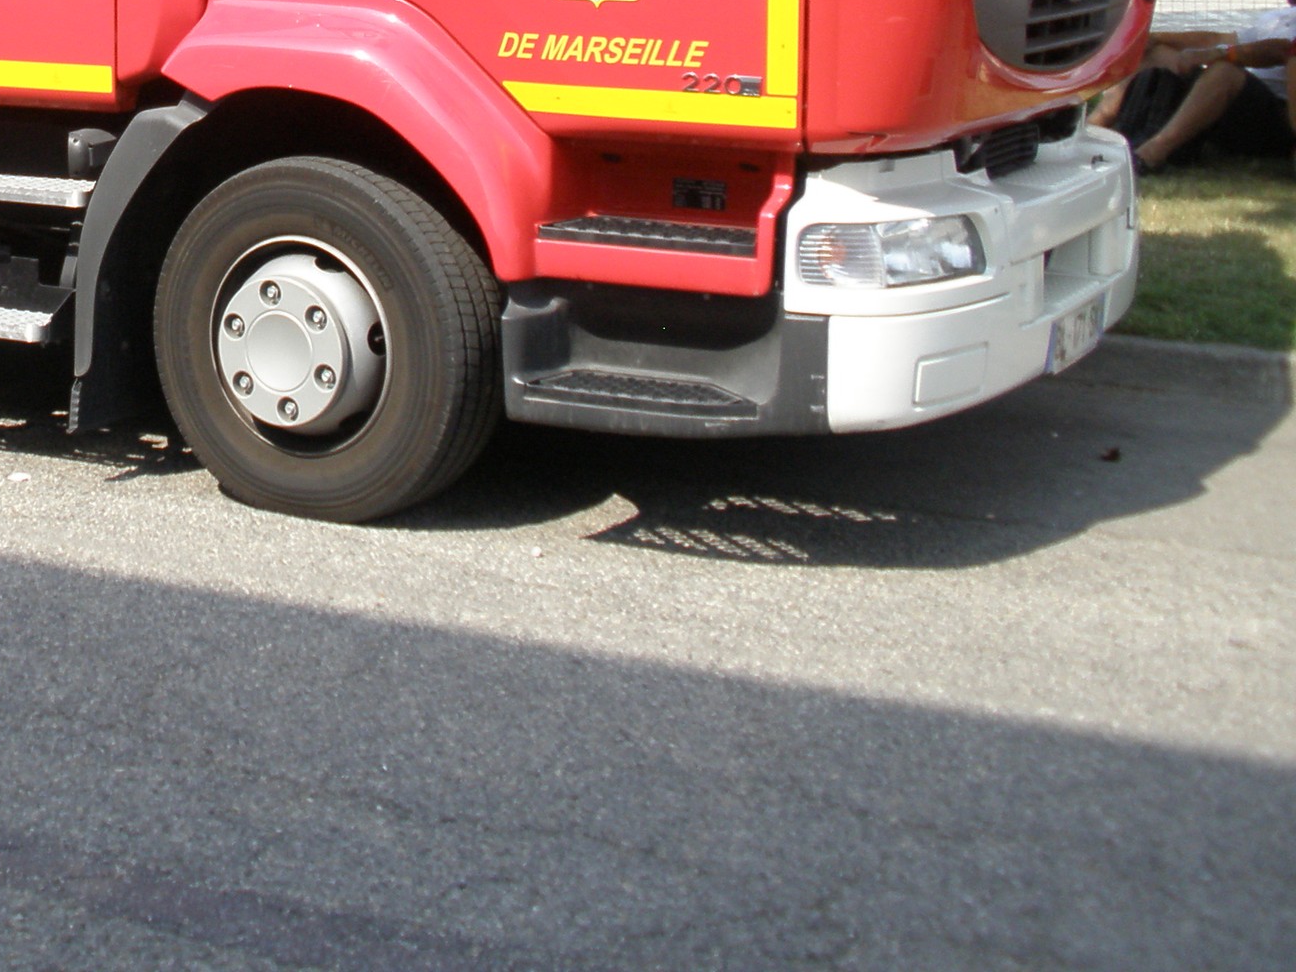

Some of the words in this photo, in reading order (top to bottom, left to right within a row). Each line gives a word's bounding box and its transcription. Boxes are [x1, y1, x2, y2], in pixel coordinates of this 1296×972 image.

[498, 32, 538, 59] DE
[541, 34, 708, 67] MARSEILLE
[682, 71, 742, 96] 220
